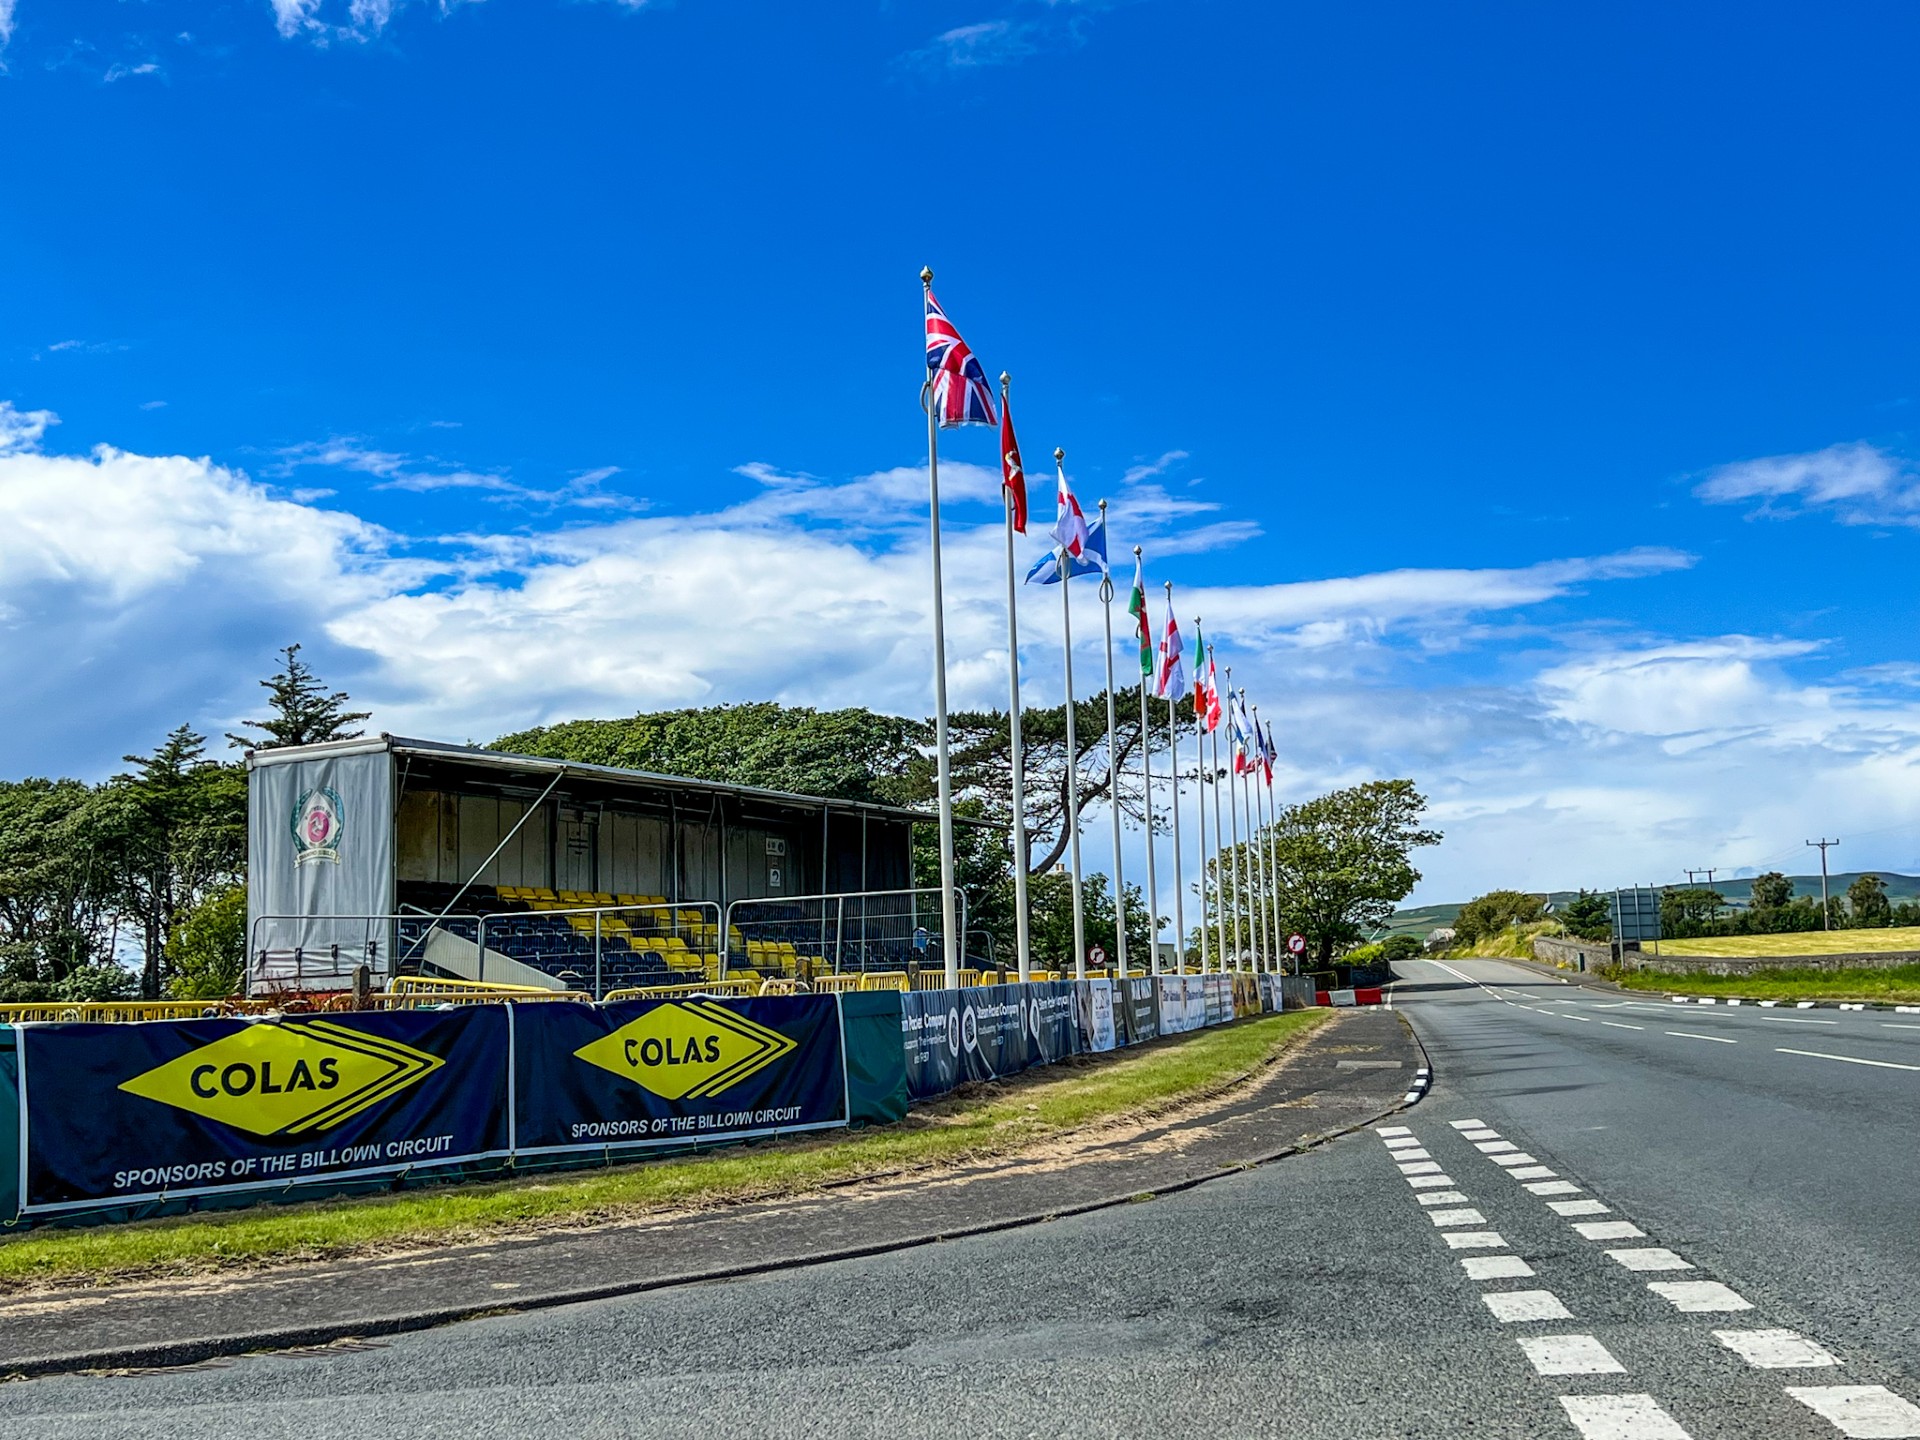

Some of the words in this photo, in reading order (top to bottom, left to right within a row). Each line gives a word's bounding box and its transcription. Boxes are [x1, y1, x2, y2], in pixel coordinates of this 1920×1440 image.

[624, 1035, 720, 1067] COLAS
[190, 1057, 339, 1099] COLAS
[571, 1119, 649, 1139] SPONSORS
[651, 1118, 669, 1133] OF
[670, 1115, 696, 1131] THE
[698, 1110, 753, 1130] BILLOWN
[755, 1106, 802, 1124] CIRCUIT
[113, 1160, 226, 1189] SPONSORS
[230, 1157, 258, 1176] OF
[260, 1154, 296, 1175] THE
[300, 1143, 384, 1169] BILLOWN
[386, 1135, 454, 1158] CIRCUIT
